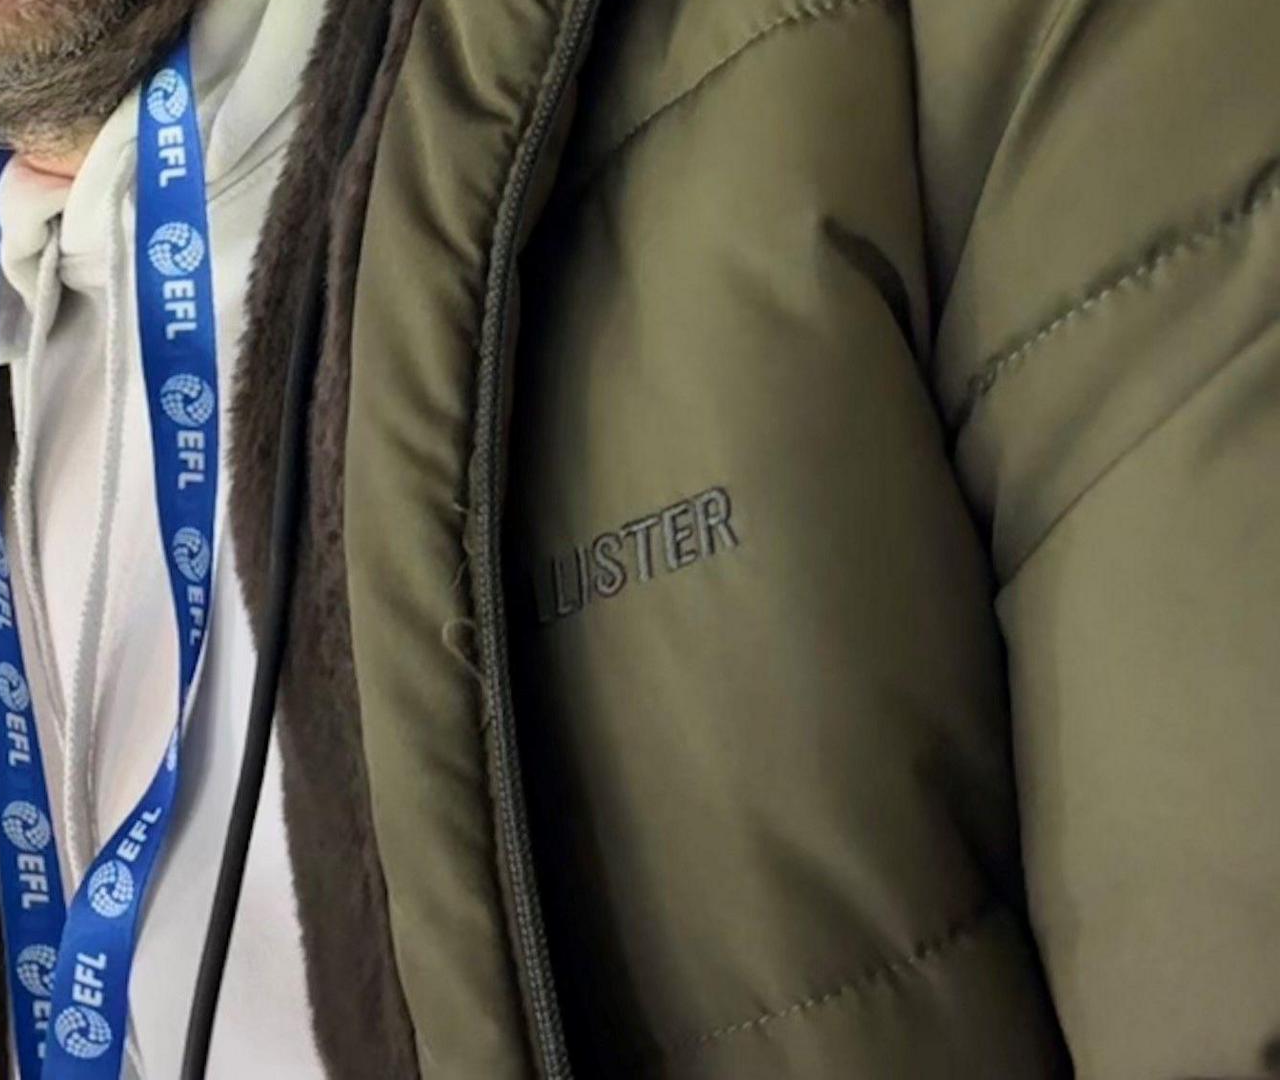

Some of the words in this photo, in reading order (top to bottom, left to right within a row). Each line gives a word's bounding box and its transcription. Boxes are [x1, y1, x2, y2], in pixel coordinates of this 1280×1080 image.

[159, 124, 187, 188] EFL
[162, 280, 197, 340] EFL
[177, 430, 206, 490] EFL
[538, 485, 739, 622] LISTER
[186, 584, 205, 647] EFL
[5, 711, 32, 767] EFL
[116, 806, 162, 862] EFL
[17, 852, 50, 910] EFL
[72, 950, 108, 1009] EFL
